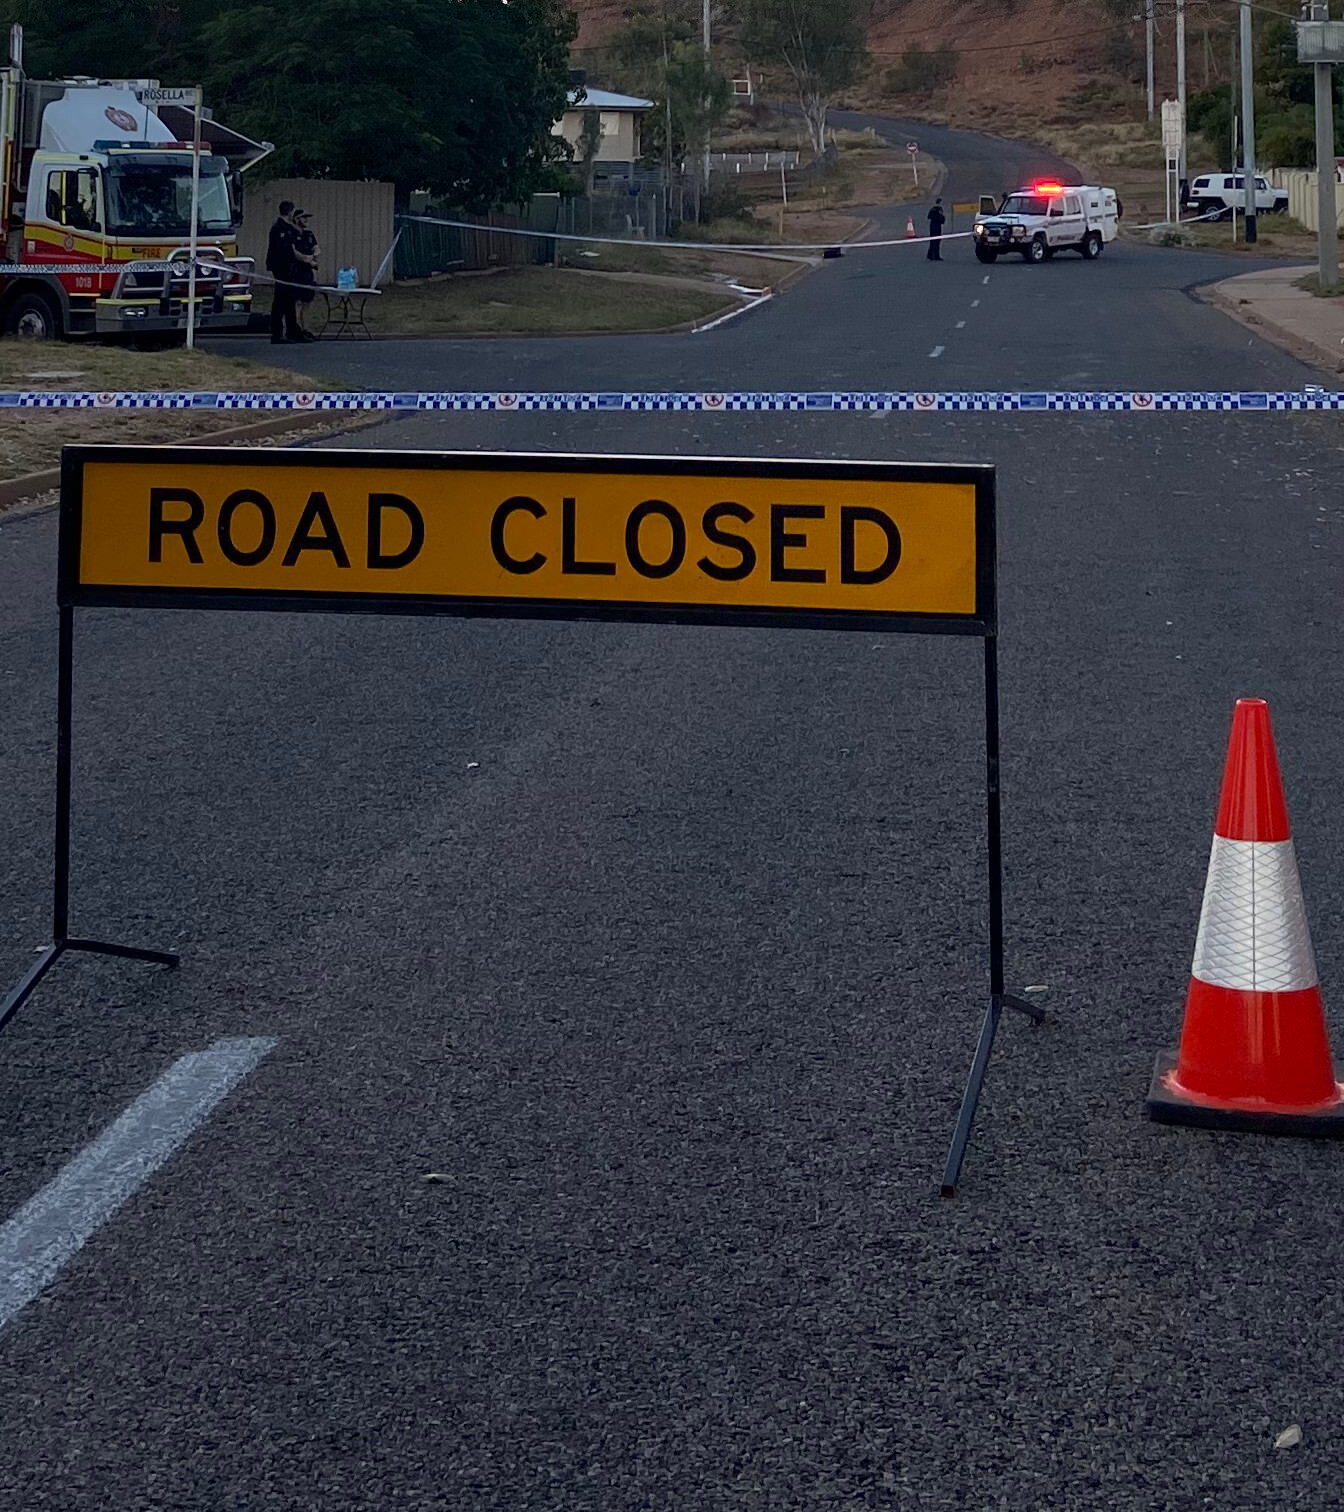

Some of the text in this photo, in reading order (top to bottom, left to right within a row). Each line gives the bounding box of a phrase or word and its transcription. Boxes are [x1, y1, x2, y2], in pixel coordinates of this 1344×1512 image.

[144, 90, 184, 100] ROSELLA
[143, 247, 161, 258] FIRE
[148, 488, 903, 587] ROAD CLOSED
